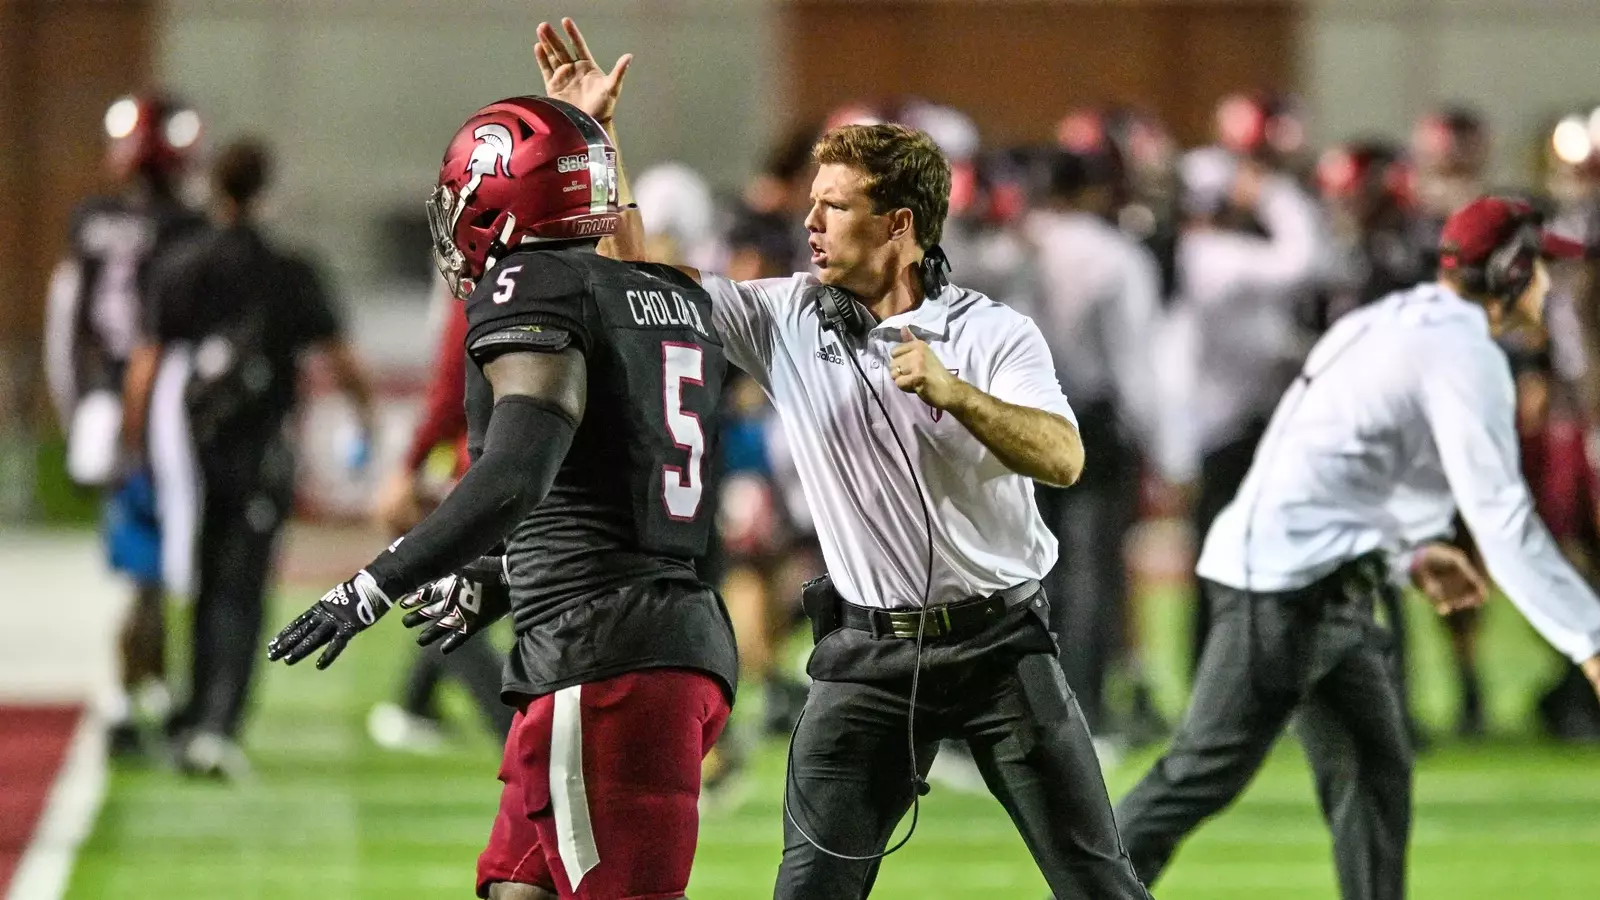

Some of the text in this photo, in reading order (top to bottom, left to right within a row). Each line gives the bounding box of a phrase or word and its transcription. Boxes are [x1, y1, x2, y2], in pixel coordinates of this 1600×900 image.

[557, 153, 590, 173] SBC
[493, 265, 524, 304] 5
[815, 351, 845, 366] adidas
[661, 341, 705, 522] 5
